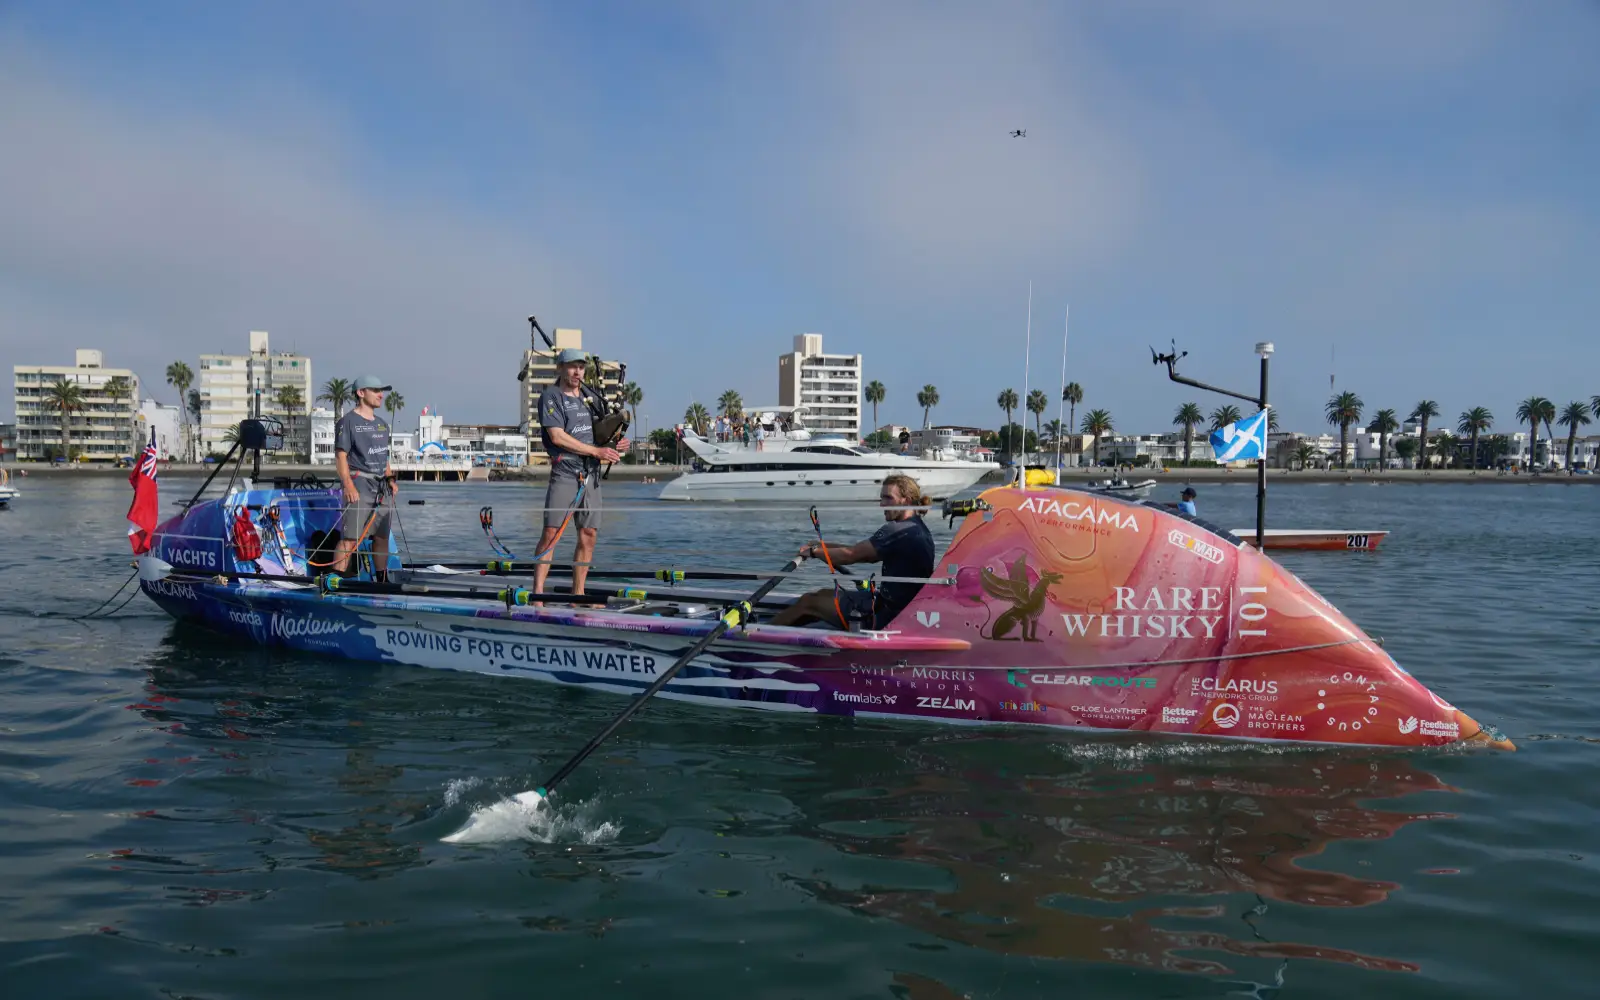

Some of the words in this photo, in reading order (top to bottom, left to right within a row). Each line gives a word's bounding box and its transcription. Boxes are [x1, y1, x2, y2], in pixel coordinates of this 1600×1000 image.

[1018, 497, 1139, 532] ATACAMA
[1040, 518, 1112, 537] PERFORMANCE
[1347, 534, 1369, 547] 207
[167, 547, 217, 566] YACHTS
[1113, 586, 1223, 611] RARE
[229, 609, 262, 626] norda
[1239, 586, 1268, 639] 101
[270, 611, 356, 639] Maclean
[1060, 613, 1224, 639] WHISKY
[386, 628, 462, 654] ROWING
[467, 638, 505, 660] FOR
[510, 643, 577, 668] CLEAN
[583, 651, 657, 675] WATER
[911, 667, 975, 681] MORRIS
[1031, 673, 1158, 689] CLEARROUTE
[852, 677, 974, 692] INTERIORS
[1190, 677, 1200, 697] THE
[1201, 677, 1278, 694] CLARUS
[833, 690, 882, 704] formlabs
[916, 696, 976, 711] ZELIM
[1200, 691, 1247, 700] NETWORKS
[1248, 694, 1278, 702] GROUP
[1071, 705, 1101, 713] CHLOE
[1103, 706, 1147, 715] LANTHIER
[1082, 713, 1136, 721] CONSULTING
[1162, 706, 1198, 716] Better
[1248, 712, 1302, 722] MACLEAN
[1248, 721, 1305, 731] BROTHERS
[1419, 727, 1460, 738] Madagascar
[1420, 719, 1459, 731] Feedback
